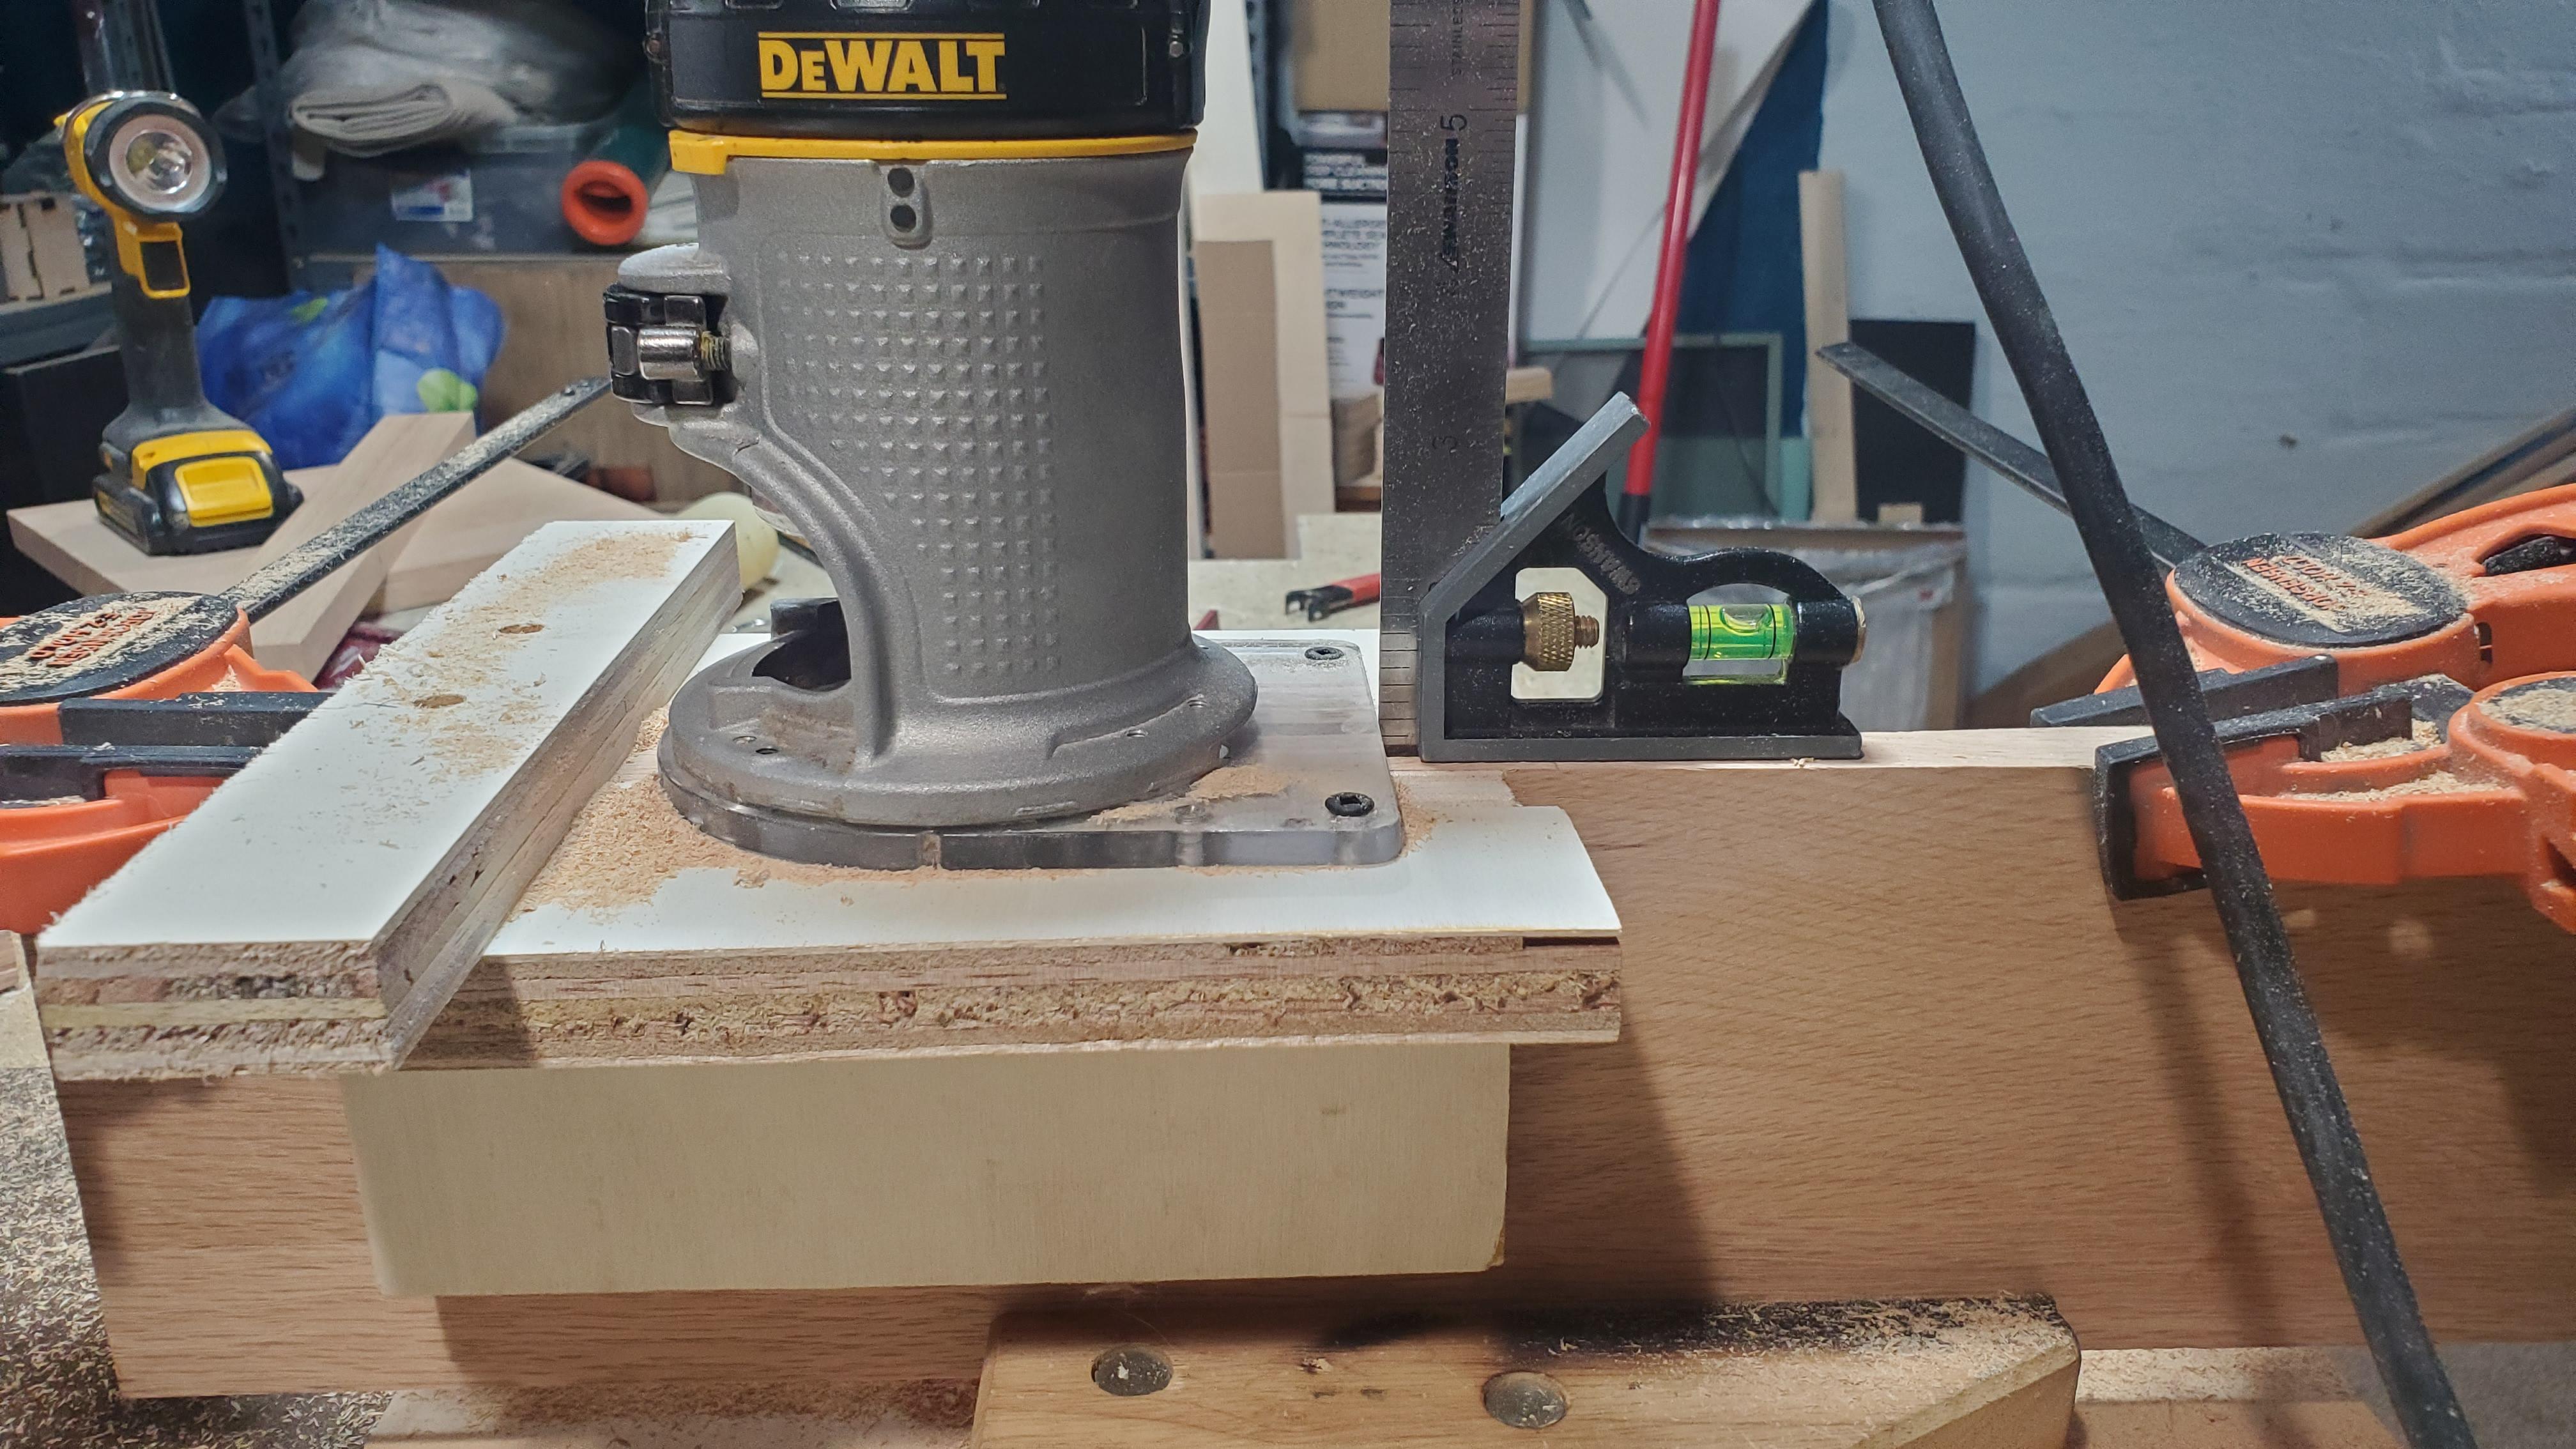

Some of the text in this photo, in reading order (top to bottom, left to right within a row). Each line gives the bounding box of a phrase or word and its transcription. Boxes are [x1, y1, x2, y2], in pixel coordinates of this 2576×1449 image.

[1440, 114, 1468, 131] 5
[1443, 138, 1459, 256] SWANSON
[1561, 512, 1641, 595] SWANSON
